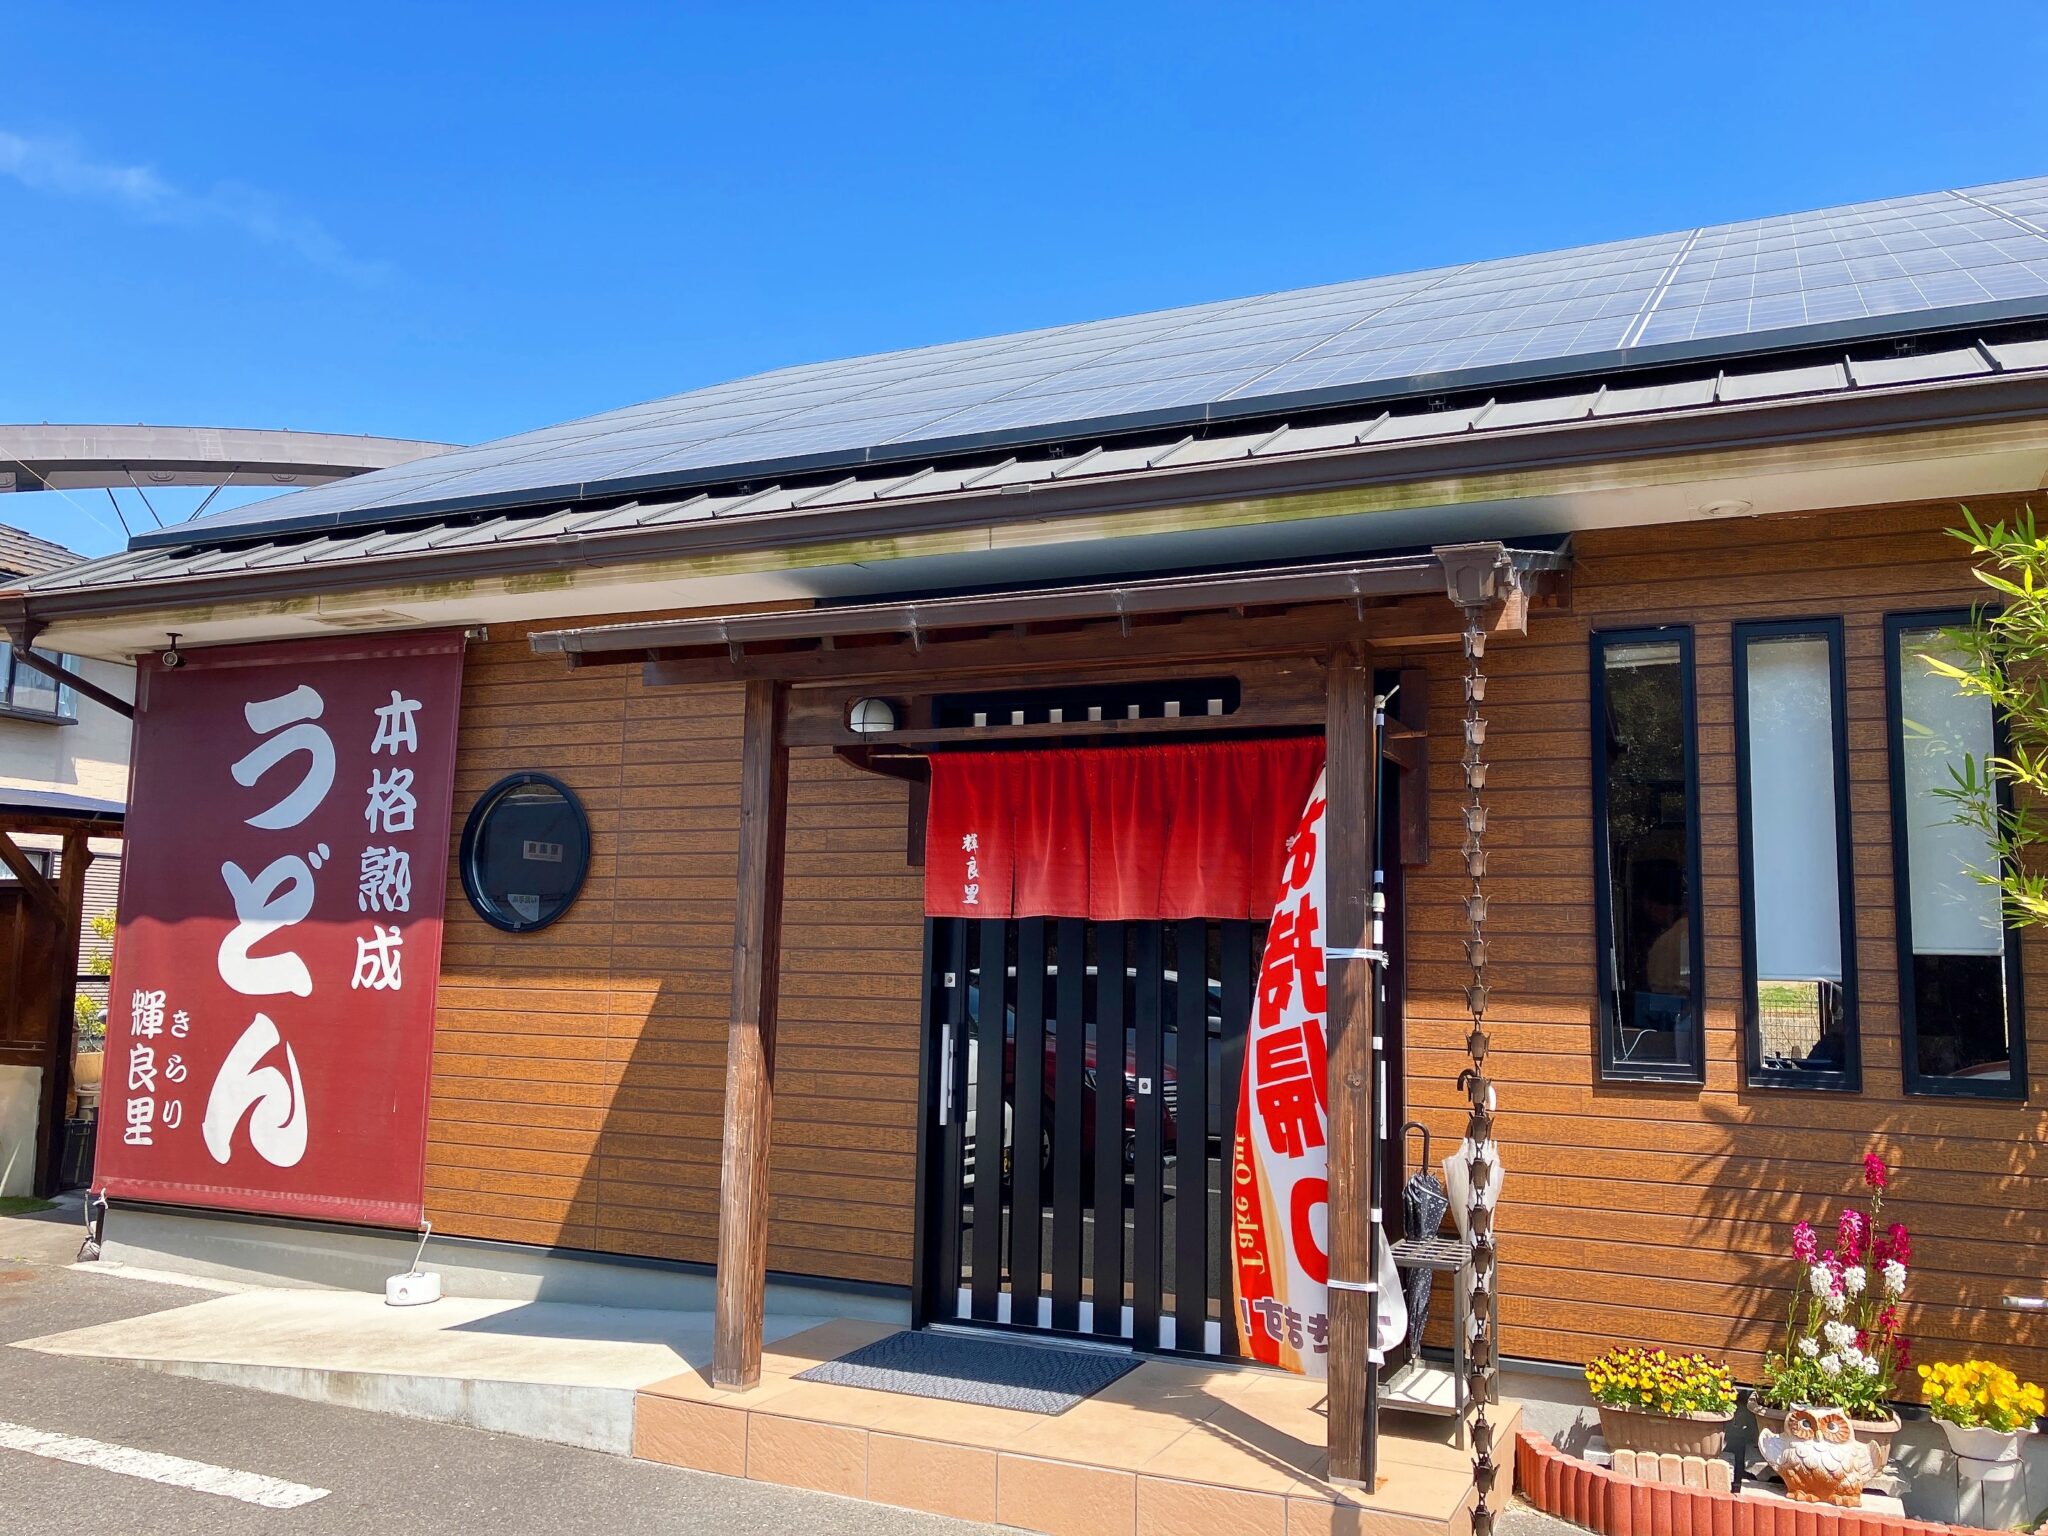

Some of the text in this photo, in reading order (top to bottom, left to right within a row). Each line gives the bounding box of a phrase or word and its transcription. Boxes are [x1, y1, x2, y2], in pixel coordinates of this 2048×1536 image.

[202, 684, 336, 1168] うどん
[350, 690, 422, 991] 本格熟成
[123, 989, 167, 1146] 輝良里
[162, 1009, 190, 1129] きらり
